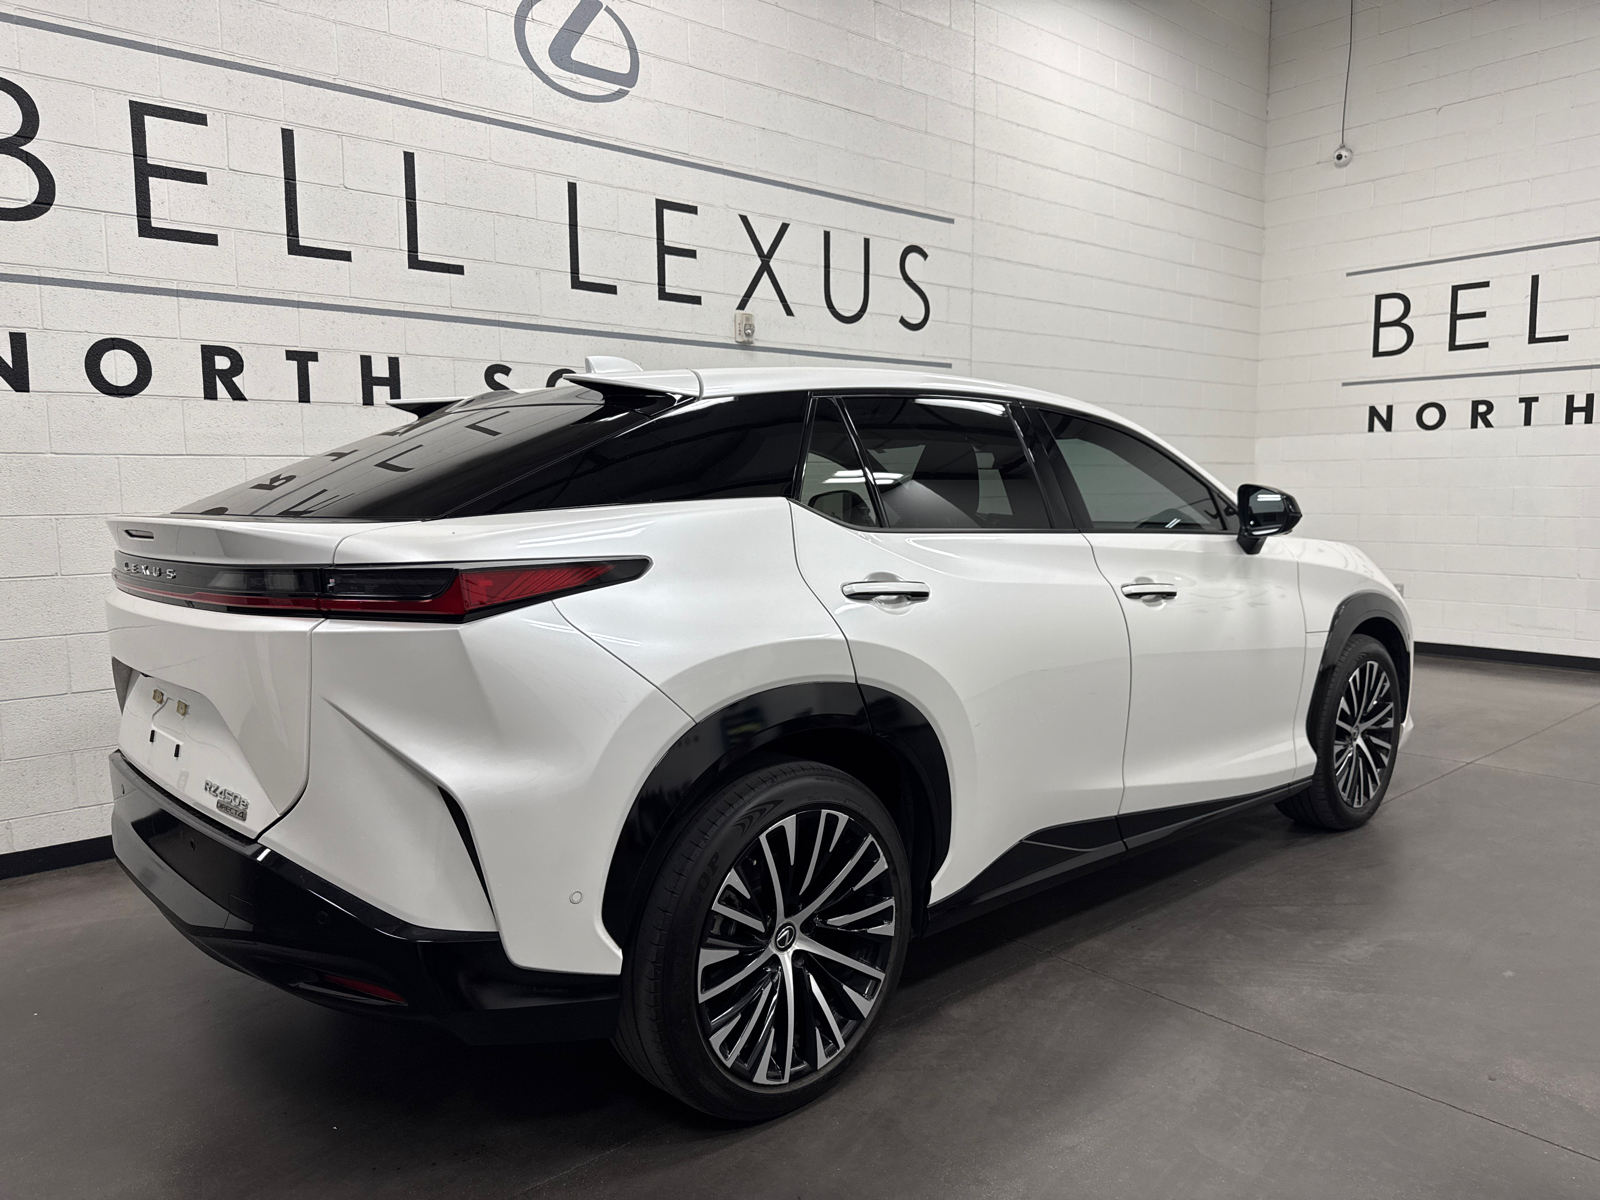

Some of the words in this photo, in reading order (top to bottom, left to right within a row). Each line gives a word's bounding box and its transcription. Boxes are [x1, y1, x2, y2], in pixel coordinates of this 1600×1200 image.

[0, 77, 465, 275] BELL
[567, 181, 931, 332] LEXUS
[1367, 393, 1595, 433] NORTH
[124, 561, 177, 579] LEXUS
